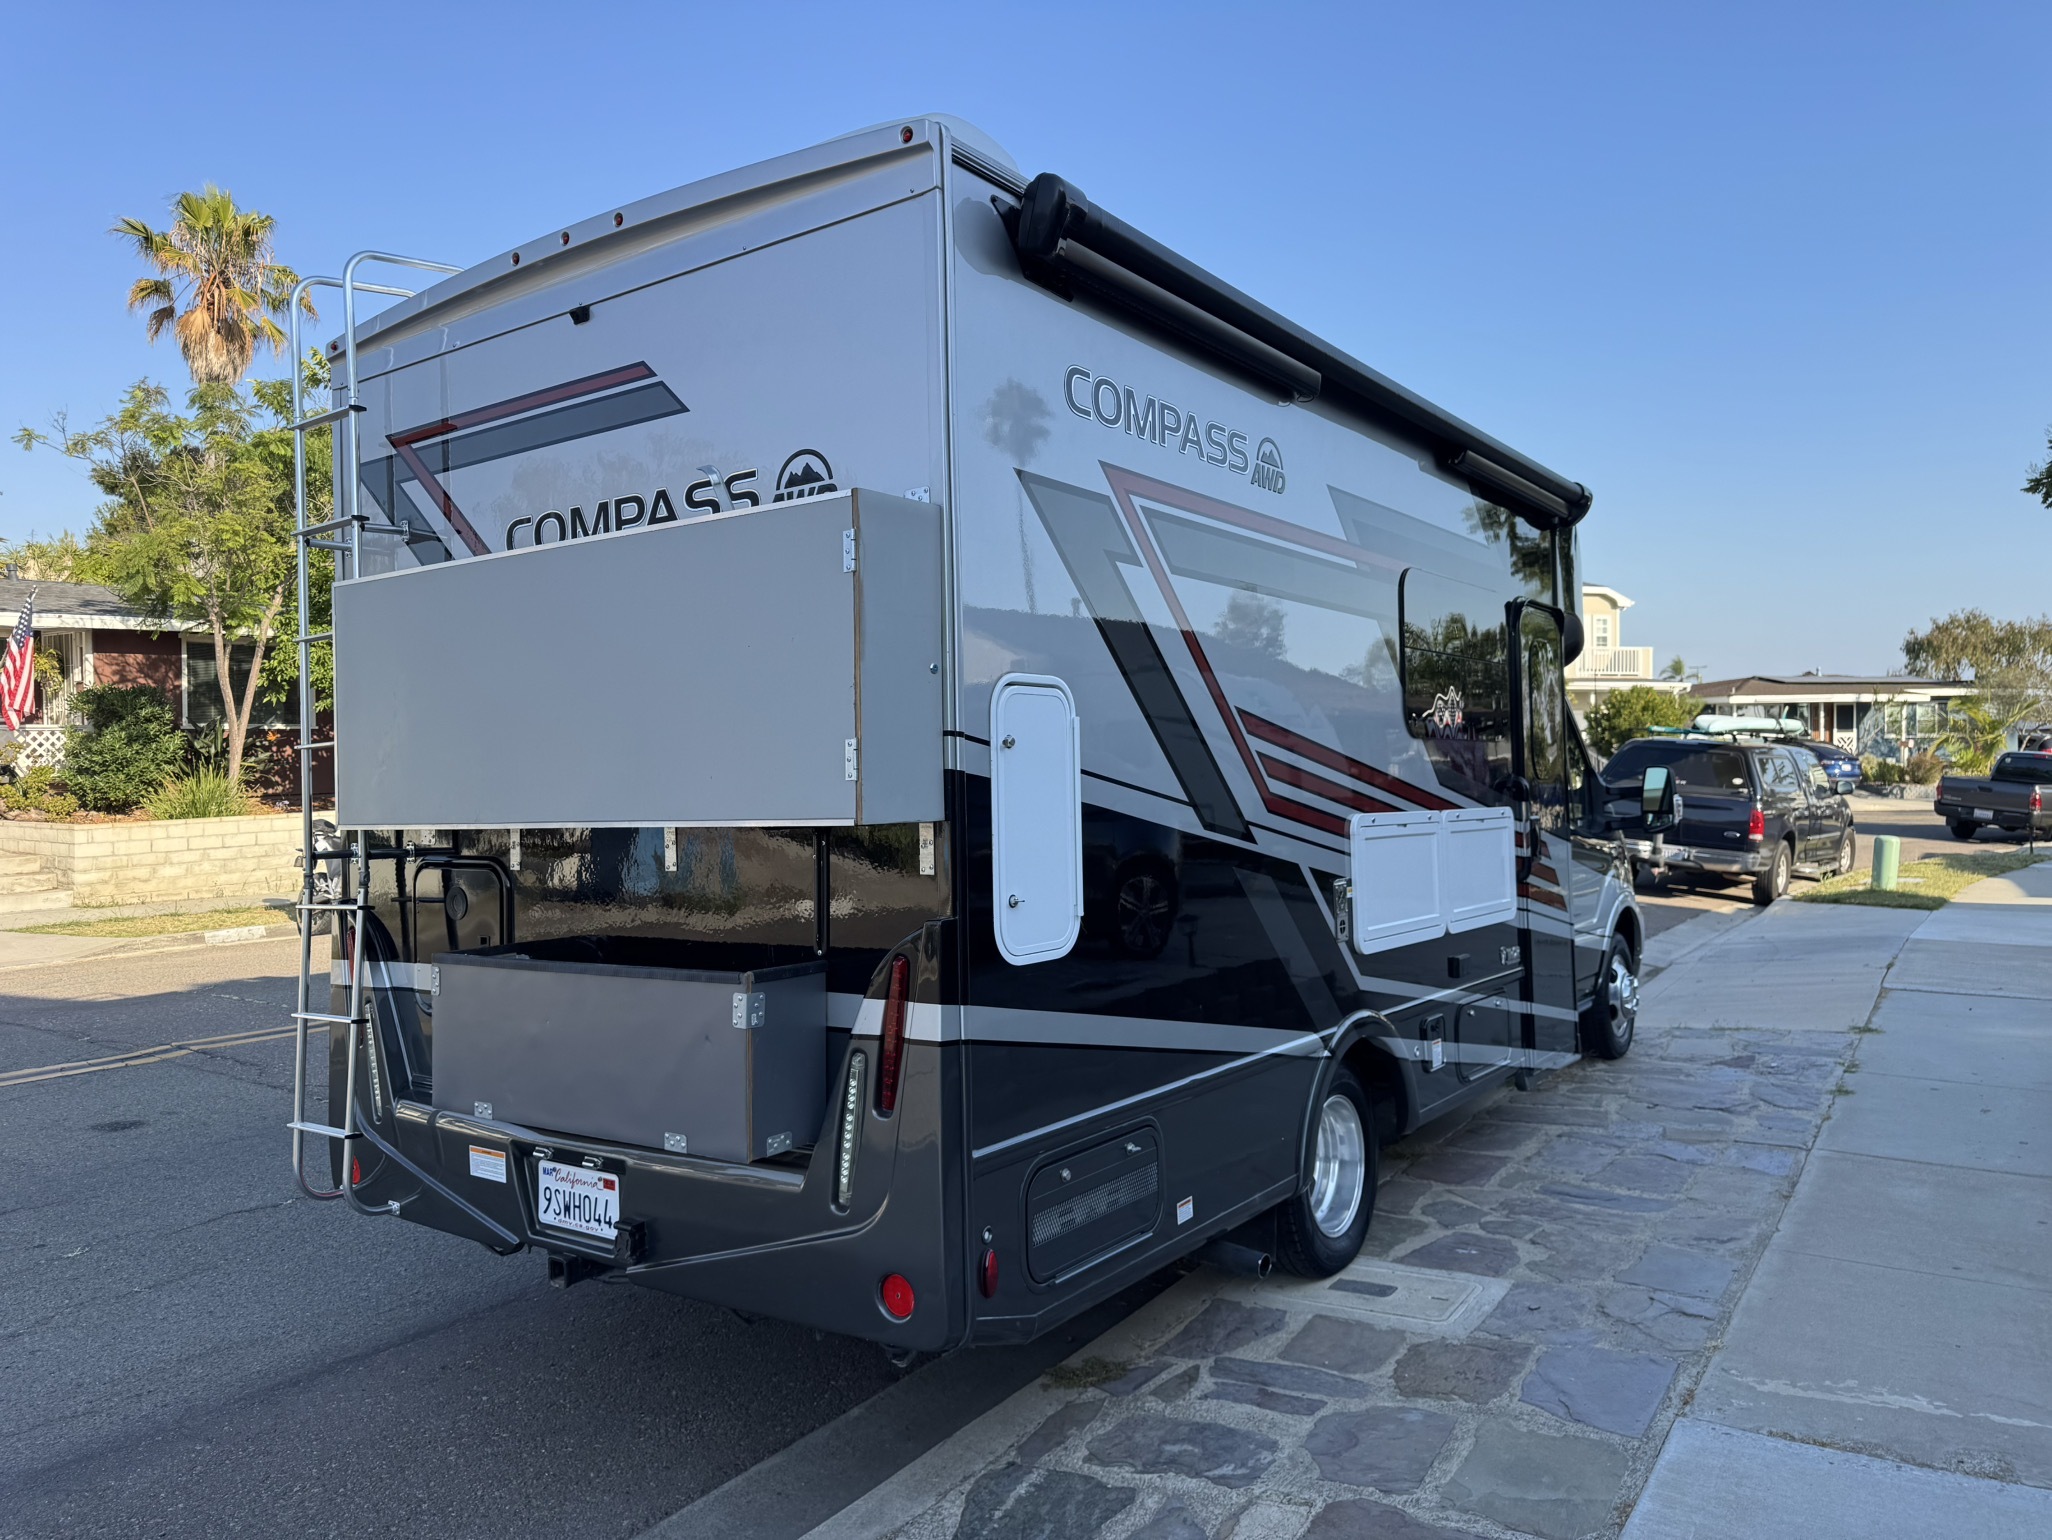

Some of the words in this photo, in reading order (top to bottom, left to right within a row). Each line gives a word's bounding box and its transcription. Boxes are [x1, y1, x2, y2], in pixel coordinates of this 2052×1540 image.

[1064, 364, 1250, 475] COMPASS
[1250, 461, 1286, 495] AWD
[505, 467, 762, 551] COMPASS
[554, 1168, 604, 1190] California
[543, 1185, 613, 1229] 9SWH044
[557, 1218, 599, 1232] dmv.ca.gov
